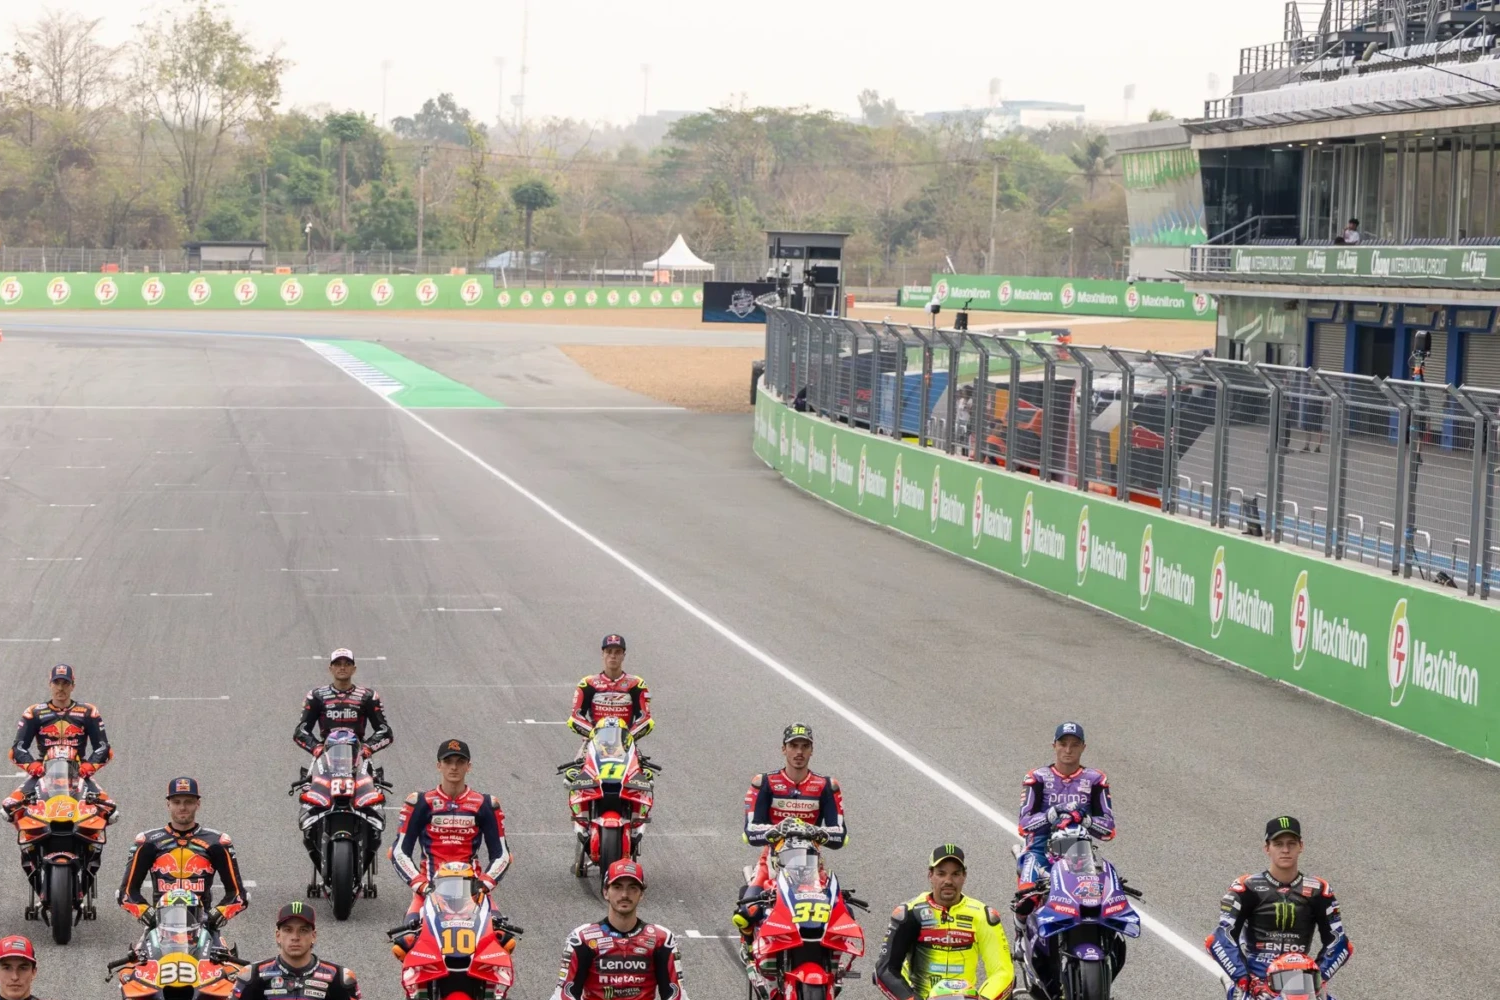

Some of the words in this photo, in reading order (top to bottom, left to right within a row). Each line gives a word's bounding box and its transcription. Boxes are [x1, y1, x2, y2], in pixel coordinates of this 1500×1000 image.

[1033, 519, 1065, 561] Maxnitron
[1090, 535, 1127, 581] Maxnitron
[1155, 557, 1195, 606] Maxnitron
[1227, 581, 1274, 636] Maxnitron
[1312, 608, 1368, 669] Maxnitron
[1412, 640, 1479, 707] Maxnitron
[326, 709, 358, 720] aprilia
[595, 705, 629, 713] HONDA
[791, 727, 806, 735] 36
[599, 762, 626, 779] 11
[330, 778, 355, 796] 89
[785, 801, 815, 809] Castrol
[1049, 794, 1088, 806] prima
[773, 811, 816, 819] HONDA
[442, 816, 474, 826] Castrol
[1027, 820, 1048, 832] PRAMAC
[430, 826, 476, 834] HONDA
[157, 878, 180, 892] Red
[182, 878, 205, 892] Bull
[1072, 881, 1104, 899] 43
[802, 892, 827, 900] Castrol
[1050, 894, 1072, 905] prima
[1107, 895, 1126, 906] prima
[792, 901, 831, 923] 36
[1055, 904, 1076, 914] MOTUL
[1105, 905, 1123, 914] MOTUL
[766, 921, 792, 930] HONDA
[833, 923, 857, 931] HONDA
[441, 928, 476, 955] 10
[1265, 942, 1306, 952] ENEOS
[410, 951, 437, 960] HONDA
[480, 951, 508, 960] HONDA
[1211, 940, 1237, 976] YAMAHA
[599, 959, 647, 970] Lenovo
[1324, 948, 1349, 978] YAMAHA
[160, 961, 198, 985] 33
[609, 975, 647, 985] NetApp
